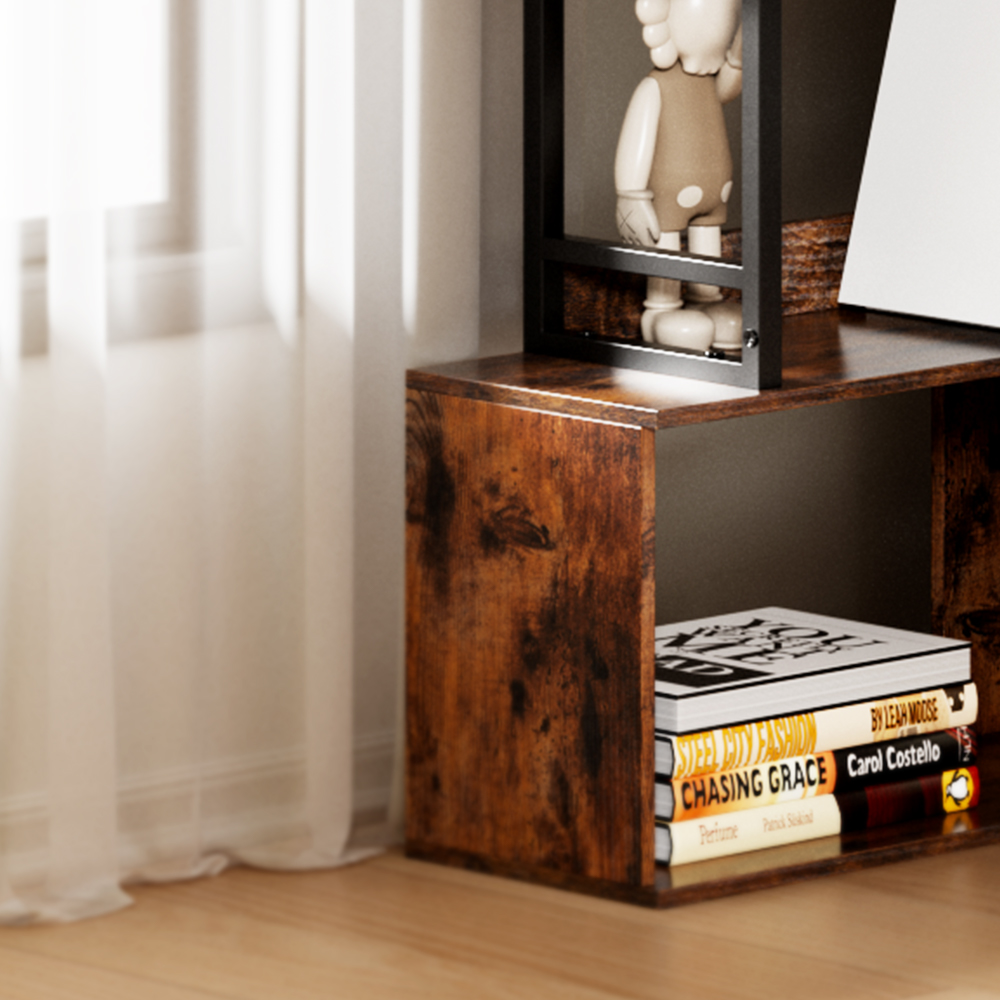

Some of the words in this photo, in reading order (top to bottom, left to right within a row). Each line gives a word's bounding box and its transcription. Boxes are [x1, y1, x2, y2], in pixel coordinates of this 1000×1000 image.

[870, 707, 882, 733] BY
[884, 702, 907, 729] LEAH
[674, 730, 719, 779] STEEL
[719, 724, 753, 771] CITY
[754, 712, 817, 764] FASHION
[847, 749, 883, 777] Carol
[886, 739, 940, 770] Costello
[681, 769, 763, 811] CHASING
[768, 756, 827, 794] GRACE
[699, 821, 738, 845] Perfume
